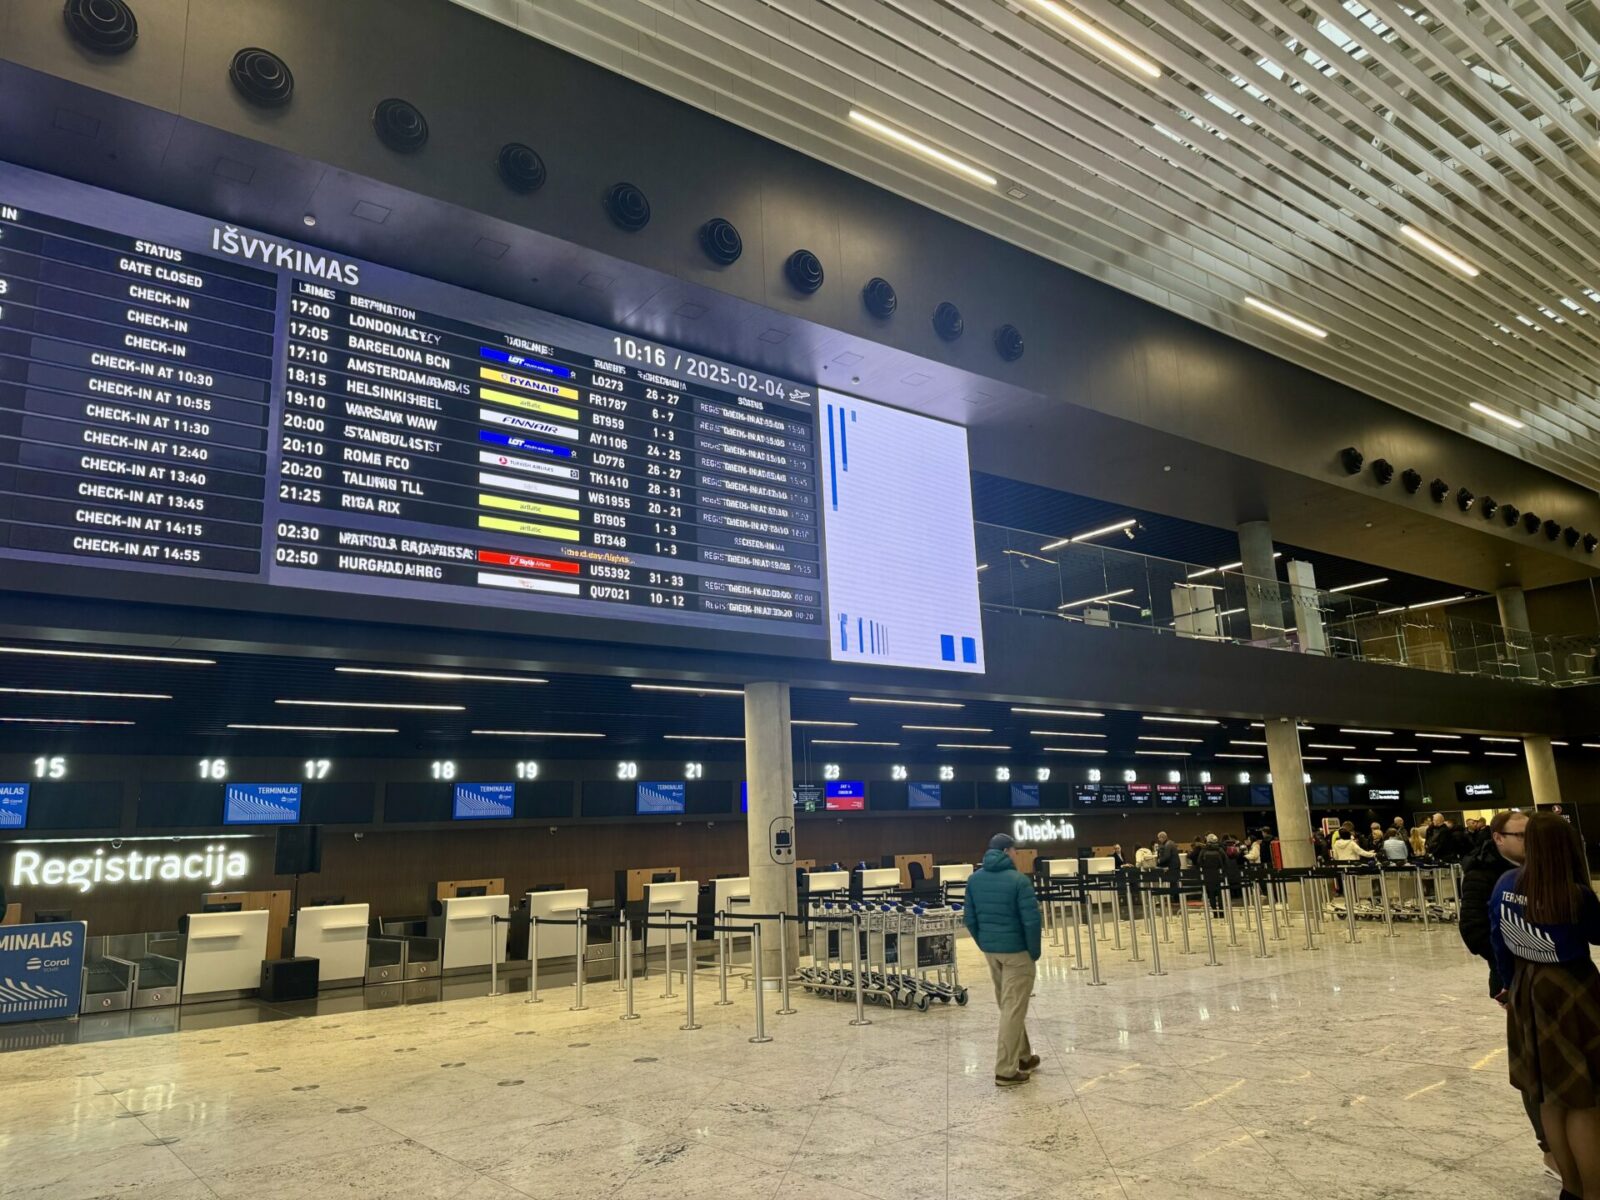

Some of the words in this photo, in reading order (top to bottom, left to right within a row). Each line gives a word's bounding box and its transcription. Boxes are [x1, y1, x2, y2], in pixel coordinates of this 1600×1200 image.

[2, 206, 18, 220] IN
[135, 241, 182, 262] STATUS
[212, 225, 360, 286] IŠVYKIMAS
[120, 258, 152, 277] GATE
[155, 268, 203, 288] CLOSED
[129, 285, 190, 309] CHECK-IN
[291, 299, 330, 319] 17:00
[127, 310, 188, 333] CHECK-IN
[290, 322, 329, 341] 17:05
[125, 334, 186, 357] CHECK-IN
[289, 344, 328, 364] 17:10
[91, 353, 154, 376] CHECK-IN
[157, 366, 174, 380] AT
[178, 369, 213, 387] 10:30
[425, 352, 451, 370] BCN
[614, 336, 666, 367] 10:16
[687, 357, 786, 399] 2025-02-04
[287, 367, 327, 387] 18:15
[509, 376, 560, 395] RYANAIR
[89, 379, 152, 401] CHECK-IN
[155, 392, 172, 404] AT
[176, 393, 211, 411] 10:55
[286, 390, 326, 409] 19:10
[589, 393, 627, 411] FR1787
[646, 388, 659, 400] 26
[667, 393, 680, 405] 27
[86, 404, 150, 426] CHECK-IN
[153, 417, 170, 429] AT
[174, 419, 210, 435] 11:30
[284, 413, 325, 432] 20:00
[407, 411, 438, 432] WAW
[592, 413, 625, 430] BT959
[652, 408, 659, 419] 6
[668, 412, 674, 422] 7
[502, 416, 559, 434] FINNAIR
[653, 427, 658, 438] 1
[668, 430, 675, 441] 3
[84, 430, 148, 451] CHECK-IN
[151, 442, 168, 454] AT
[172, 444, 208, 460] 12:40
[282, 437, 324, 456] 20:10
[589, 432, 628, 450] AY1106
[647, 445, 660, 457] 24
[668, 449, 681, 461] 25
[81, 456, 146, 477] CHECK-IN
[149, 468, 166, 480] AT
[170, 469, 206, 485] 13:40
[281, 461, 322, 479] 20:20
[386, 455, 410, 470] FCO
[590, 471, 629, 489] TK1410
[647, 464, 660, 476] 26
[669, 468, 681, 480] 27
[78, 483, 144, 503] CHECK-IN
[147, 493, 164, 505] AT
[168, 495, 204, 511] 13:45
[279, 485, 321, 503] 21:25
[401, 481, 424, 496] TLL
[648, 483, 660, 495] 28
[669, 486, 681, 498] 31
[378, 499, 401, 515] RIX
[588, 491, 631, 509] W61955
[648, 502, 661, 514] 20
[670, 506, 682, 518] 21
[76, 509, 141, 529] CHECK-IN
[145, 519, 162, 531] AT
[166, 521, 203, 536] 14:15
[593, 512, 626, 528] BT905
[277, 523, 320, 541] 02:30
[655, 523, 660, 533] 1
[670, 525, 677, 536] 3
[73, 537, 139, 555] CHECK-IN
[142, 546, 159, 558] AT
[164, 547, 201, 562] 14:55
[593, 533, 627, 548] BT348
[655, 542, 660, 552] 1
[671, 545, 677, 555] 3
[276, 548, 318, 565] 02:50
[649, 572, 661, 584] 31
[671, 575, 684, 587] 33
[590, 586, 630, 600] QU7021
[650, 592, 662, 604] 10
[672, 595, 684, 607] 12
[34, 757, 65, 778] 15
[199, 759, 226, 779] 16
[305, 760, 331, 779] 17
[432, 761, 455, 779] 18
[517, 761, 538, 779] 19
[617, 762, 637, 779] 20
[685, 762, 703, 779] 21
[825, 765, 840, 779] 23
[892, 766, 907, 780] 24
[940, 767, 954, 780] 25
[997, 768, 1010, 781] 26
[1037, 768, 1050, 781] 27
[480, 785, 512, 793] TERMINALAS
[1013, 819, 1075, 842] Check-in
[12, 845, 249, 893] Registracija
[43, 957, 70, 968] Coral
